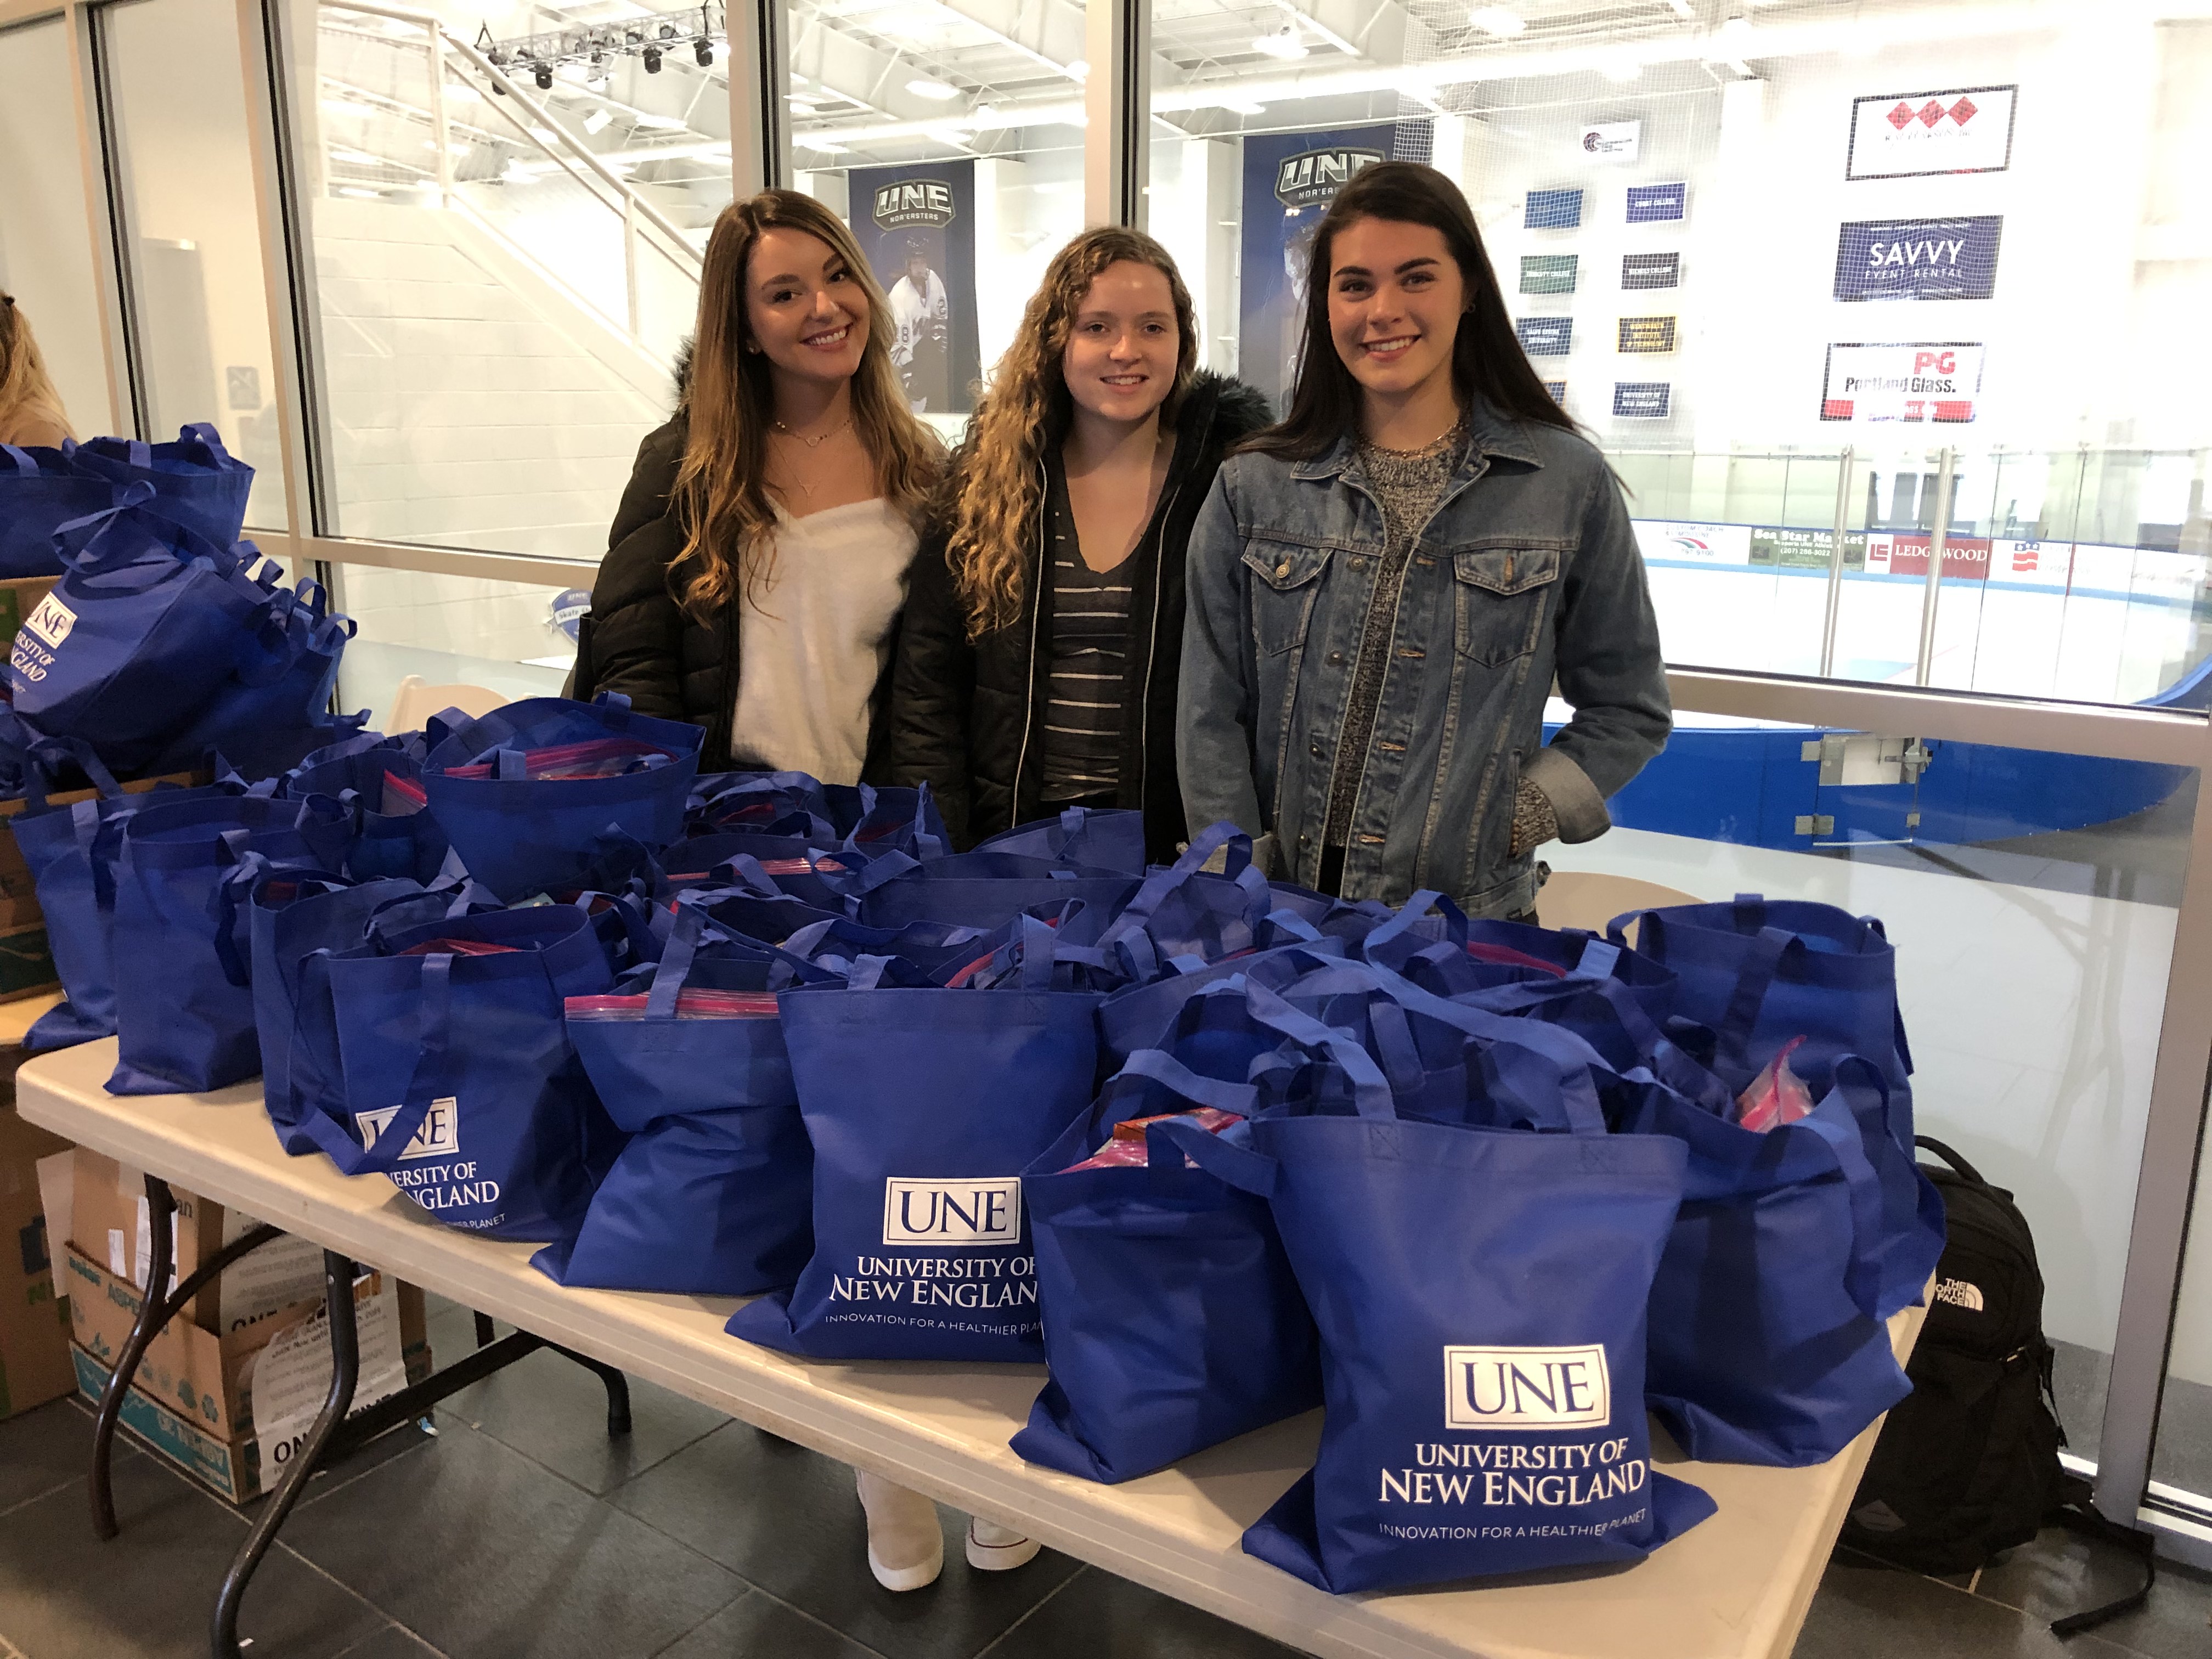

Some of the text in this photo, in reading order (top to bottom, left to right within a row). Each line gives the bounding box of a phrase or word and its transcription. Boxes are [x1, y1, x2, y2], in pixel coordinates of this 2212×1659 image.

[875, 184, 953, 217] UNE
[889, 212, 939, 223] NOR'EASTERS
[1870, 240, 1964, 266] SAVVY
[1865, 268, 1963, 279] EVENT RENTAL
[1914, 351, 1956, 375] PG
[1754, 528, 1778, 540] Sea
[1781, 530, 1810, 543] Star
[1894, 544, 1988, 562] LEDGWOOD
[454, 1161, 477, 1180] OF
[405, 1181, 500, 1210] NGLAND
[469, 1213, 505, 1229] PLANET
[898, 1190, 1007, 1233] UNE
[857, 1256, 1006, 1278] UNIVERSITY
[828, 1273, 1038, 1308] NEW ENGLAN
[1936, 1284, 1965, 1298] ORTH
[1945, 1278, 1967, 1289] THE
[1937, 1293, 1964, 1306] FACE
[825, 1313, 906, 1325] INNOVATION
[910, 1318, 934, 1328] FOR
[938, 1320, 946, 1329] A
[949, 1323, 1018, 1336] HEALTHIER
[1459, 1361, 1594, 1415] UNE
[1415, 1437, 1629, 1470] UNIVERSITY OF
[1378, 1459, 1646, 1506] NEW ENGLAND
[1379, 1508, 1647, 1540] INNOVATION FOR A HEALTHIER PLANET
